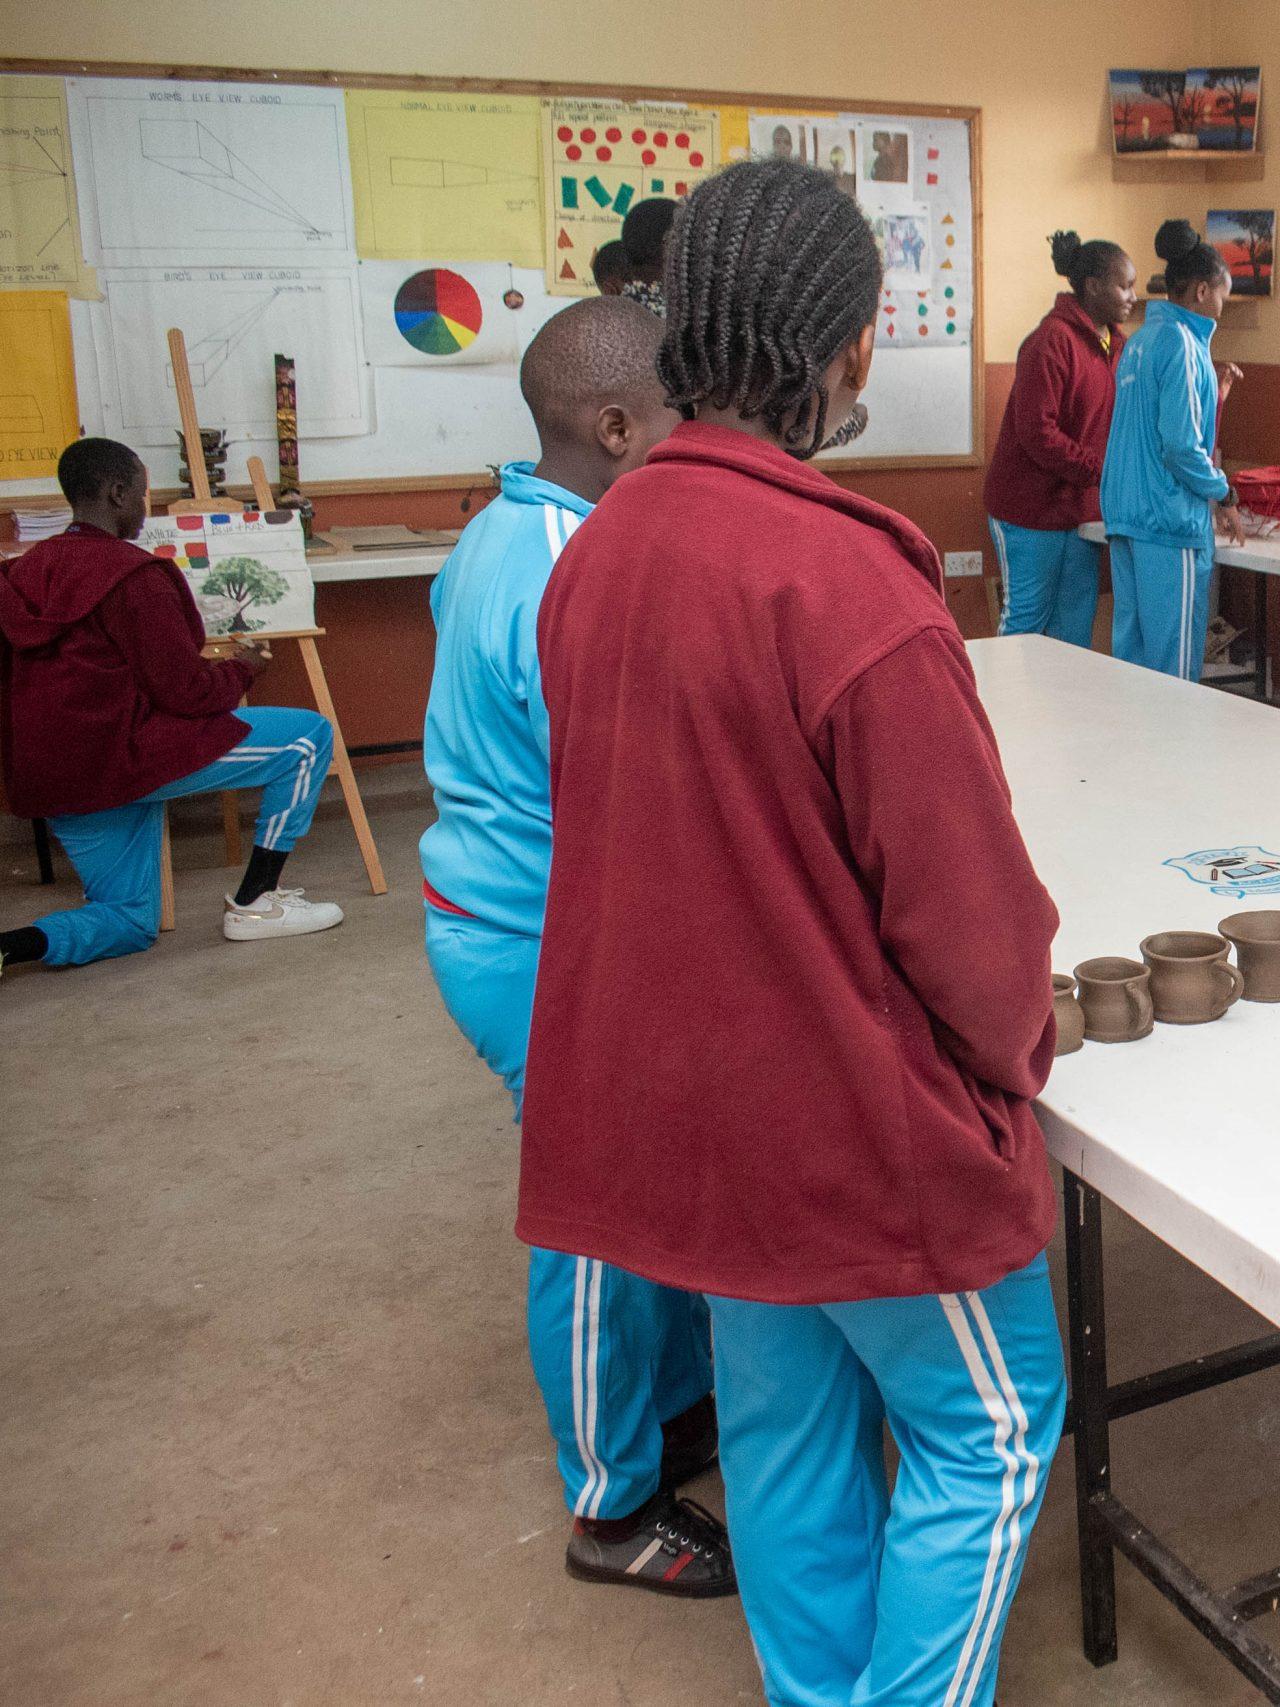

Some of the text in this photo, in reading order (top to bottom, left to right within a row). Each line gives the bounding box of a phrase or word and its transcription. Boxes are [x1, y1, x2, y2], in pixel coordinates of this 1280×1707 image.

[192, 93, 211, 102] EYE
[219, 94, 241, 103] VIEW
[250, 95, 282, 105] CUBOID
[241, 271, 263, 280] VIEW
[268, 271, 301, 280] CUBOID
[29, 446, 58, 460] VIEW
